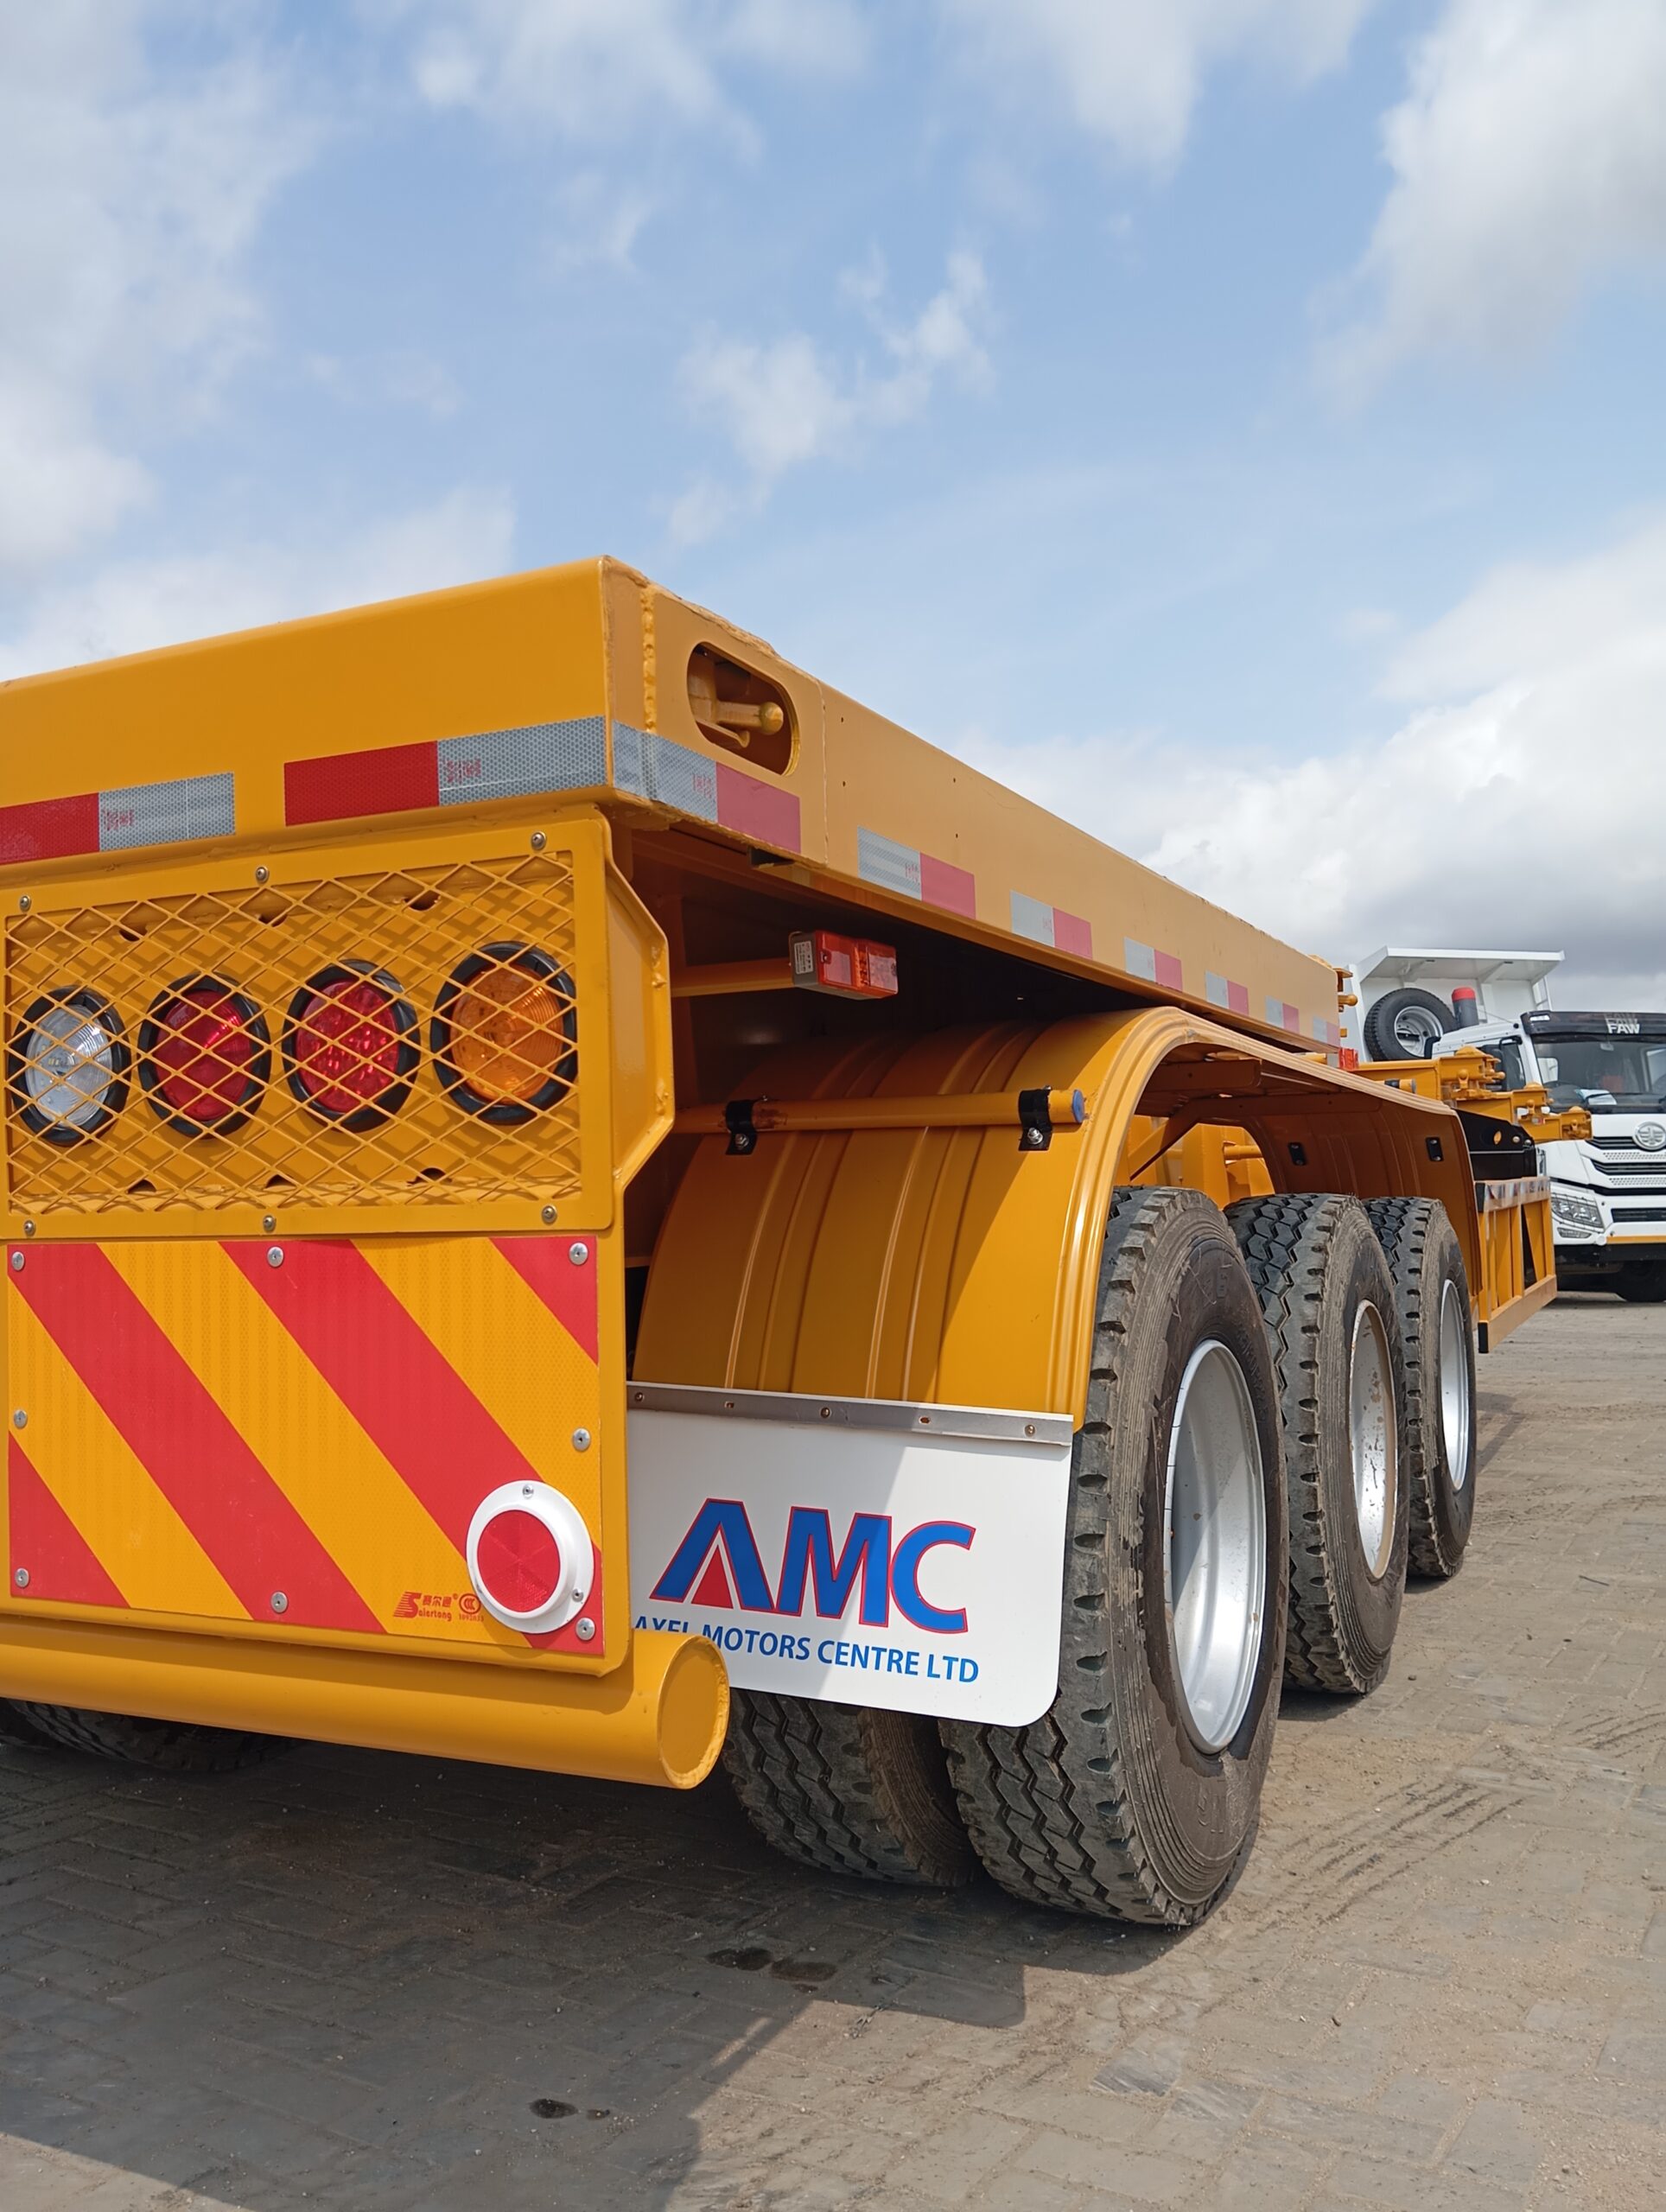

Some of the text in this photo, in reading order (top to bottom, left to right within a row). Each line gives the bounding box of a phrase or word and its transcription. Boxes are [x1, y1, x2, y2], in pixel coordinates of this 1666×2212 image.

[1607, 1023, 1640, 1034] FAW
[649, 1497, 976, 1635] AMC
[703, 1624, 811, 1661] MOTORS
[817, 1640, 920, 1676] CENTRE
[926, 1654, 979, 1683] LTD
